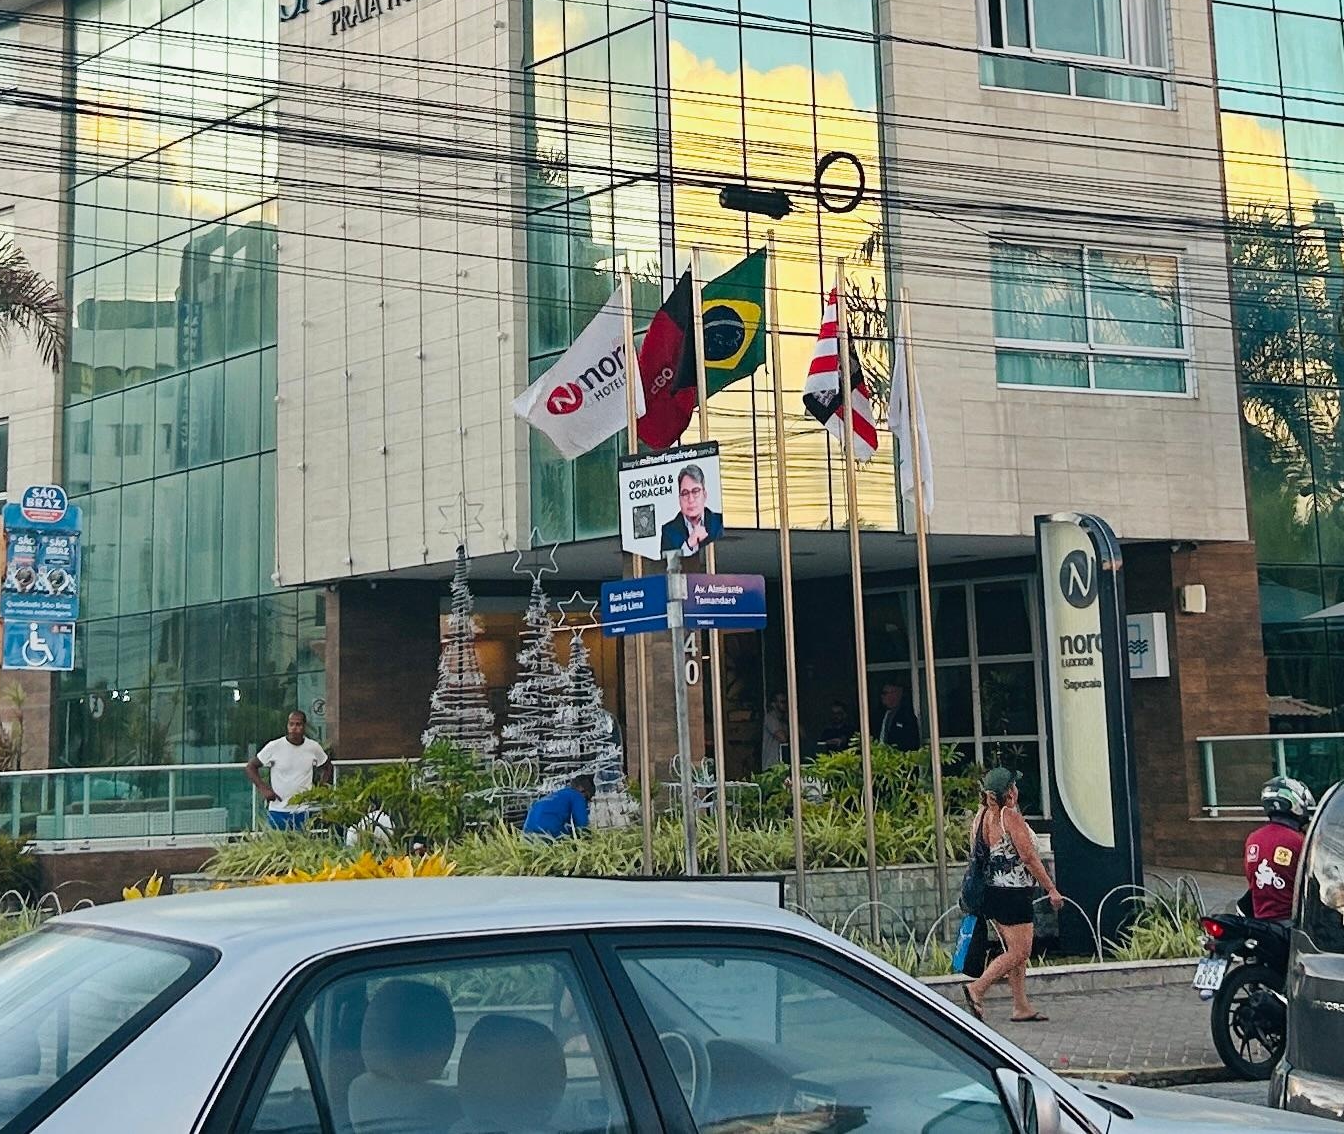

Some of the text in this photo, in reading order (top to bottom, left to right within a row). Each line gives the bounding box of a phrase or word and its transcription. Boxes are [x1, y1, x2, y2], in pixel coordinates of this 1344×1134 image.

[579, 344, 626, 389] nor
[31, 486, 58, 499] SÃO
[629, 485, 673, 501] CORAGEM
[26, 497, 61, 509] BRAZ
[707, 584, 744, 594] Almirante
[609, 592, 622, 602] Rua
[627, 601, 644, 611] Lima
[1063, 677, 1103, 693] Sapucaia
